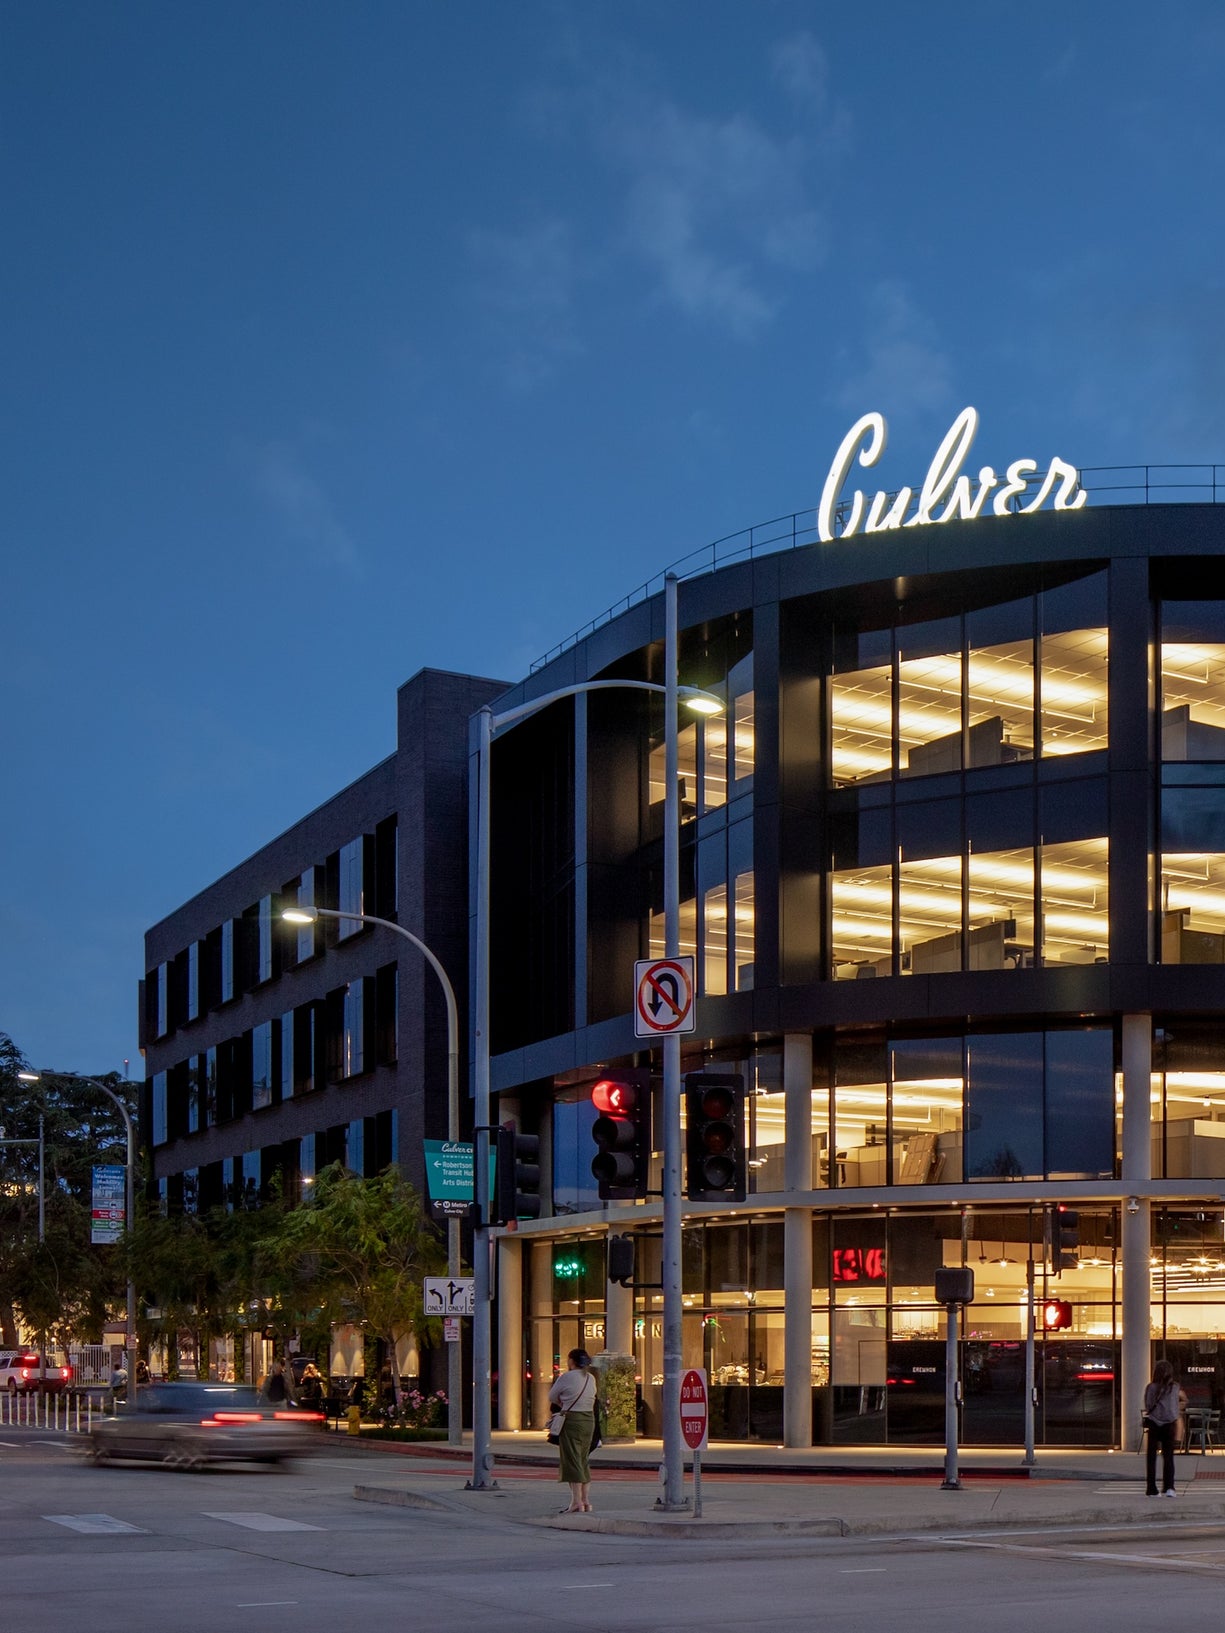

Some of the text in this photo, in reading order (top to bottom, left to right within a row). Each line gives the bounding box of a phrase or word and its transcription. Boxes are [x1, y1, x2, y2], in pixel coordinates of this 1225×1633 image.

[817, 406, 1088, 542] Culver
[441, 1143, 466, 1153] Culver
[442, 1161, 473, 1169] Robertson
[682, 1386, 703, 1399] DO NOT
[685, 1421, 702, 1434] ENTER
